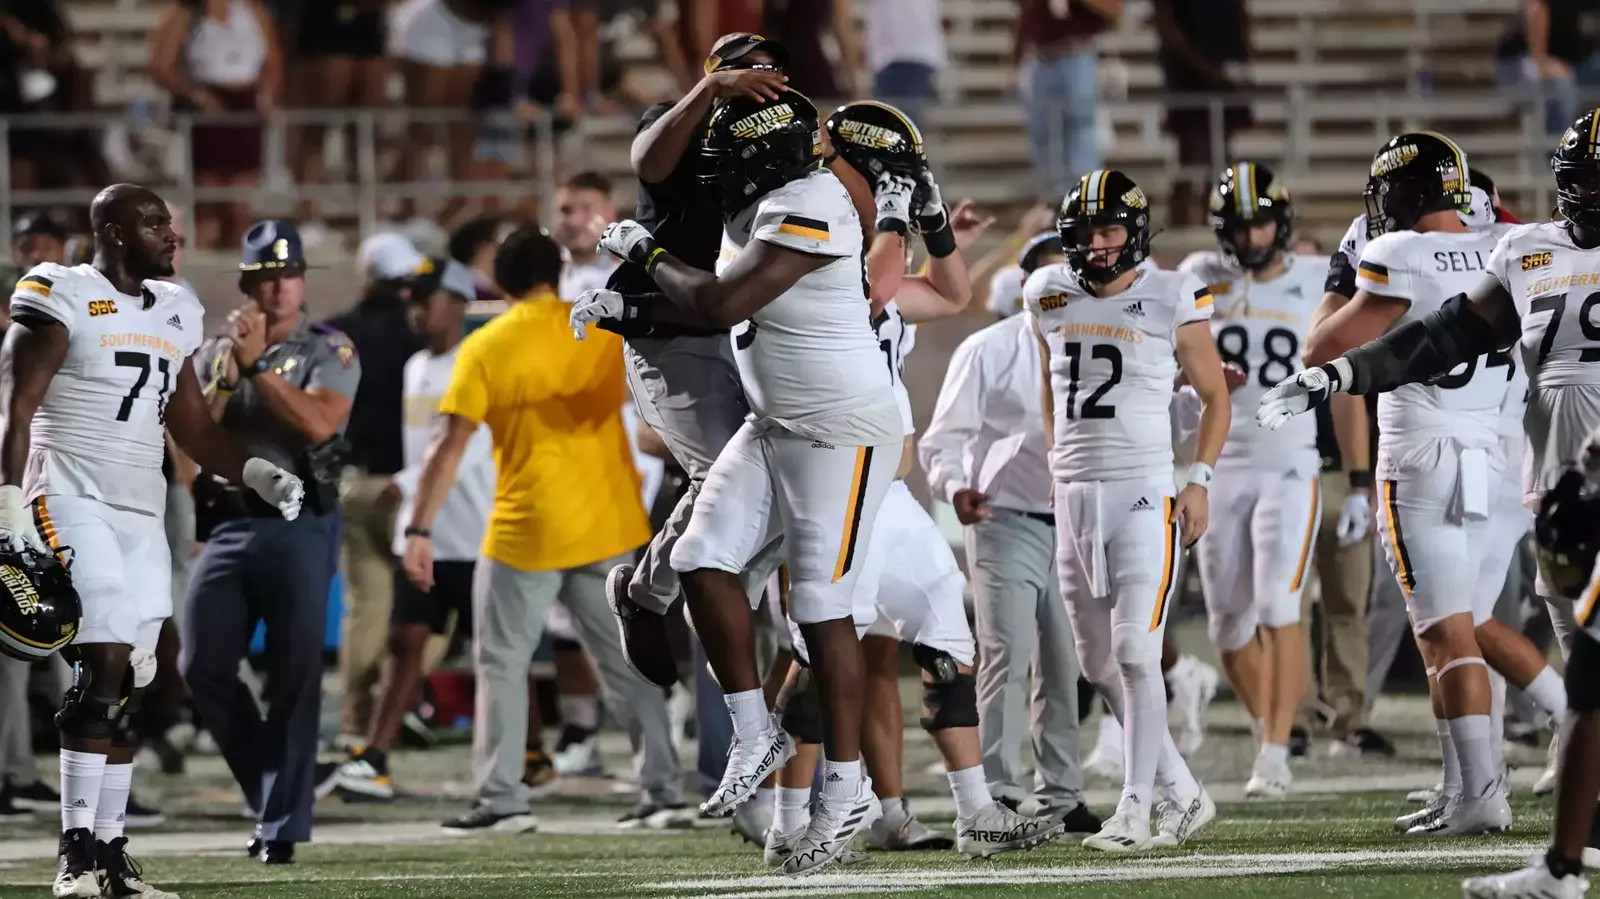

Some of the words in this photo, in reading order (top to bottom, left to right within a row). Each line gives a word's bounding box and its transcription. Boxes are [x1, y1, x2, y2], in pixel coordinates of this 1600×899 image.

[729, 103, 794, 136] SOUTHERN
[754, 118, 784, 137] MISS
[851, 132, 876, 148] MISS
[1434, 249, 1493, 272] SELL
[1522, 251, 1553, 271] SBC
[88, 299, 118, 317] SBC
[1039, 292, 1068, 312] SBC
[100, 333, 163, 349] SOUTHERN
[1115, 326, 1144, 344] MISS
[1217, 325, 1298, 388] 88
[114, 351, 171, 425] 71
[1065, 342, 1123, 420] 12
